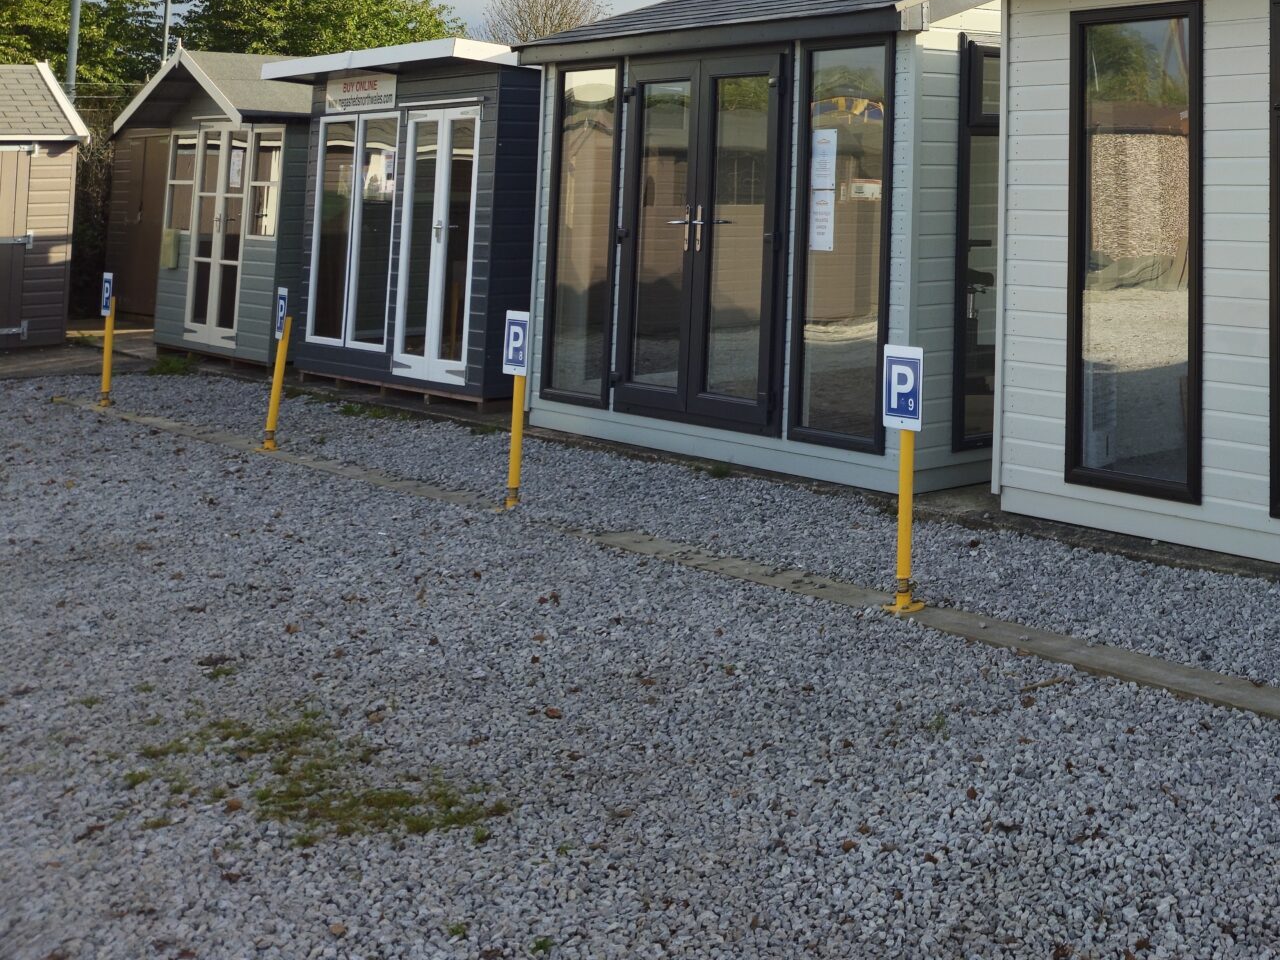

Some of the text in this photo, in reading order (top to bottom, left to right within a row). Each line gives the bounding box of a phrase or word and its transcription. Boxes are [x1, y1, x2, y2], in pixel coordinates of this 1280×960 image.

[343, 80, 378, 93] BUY ONLINE
[103, 282, 110, 306] P
[277, 300, 285, 328] P
[508, 325, 524, 361] P 8
[890, 364, 915, 411] P 9
